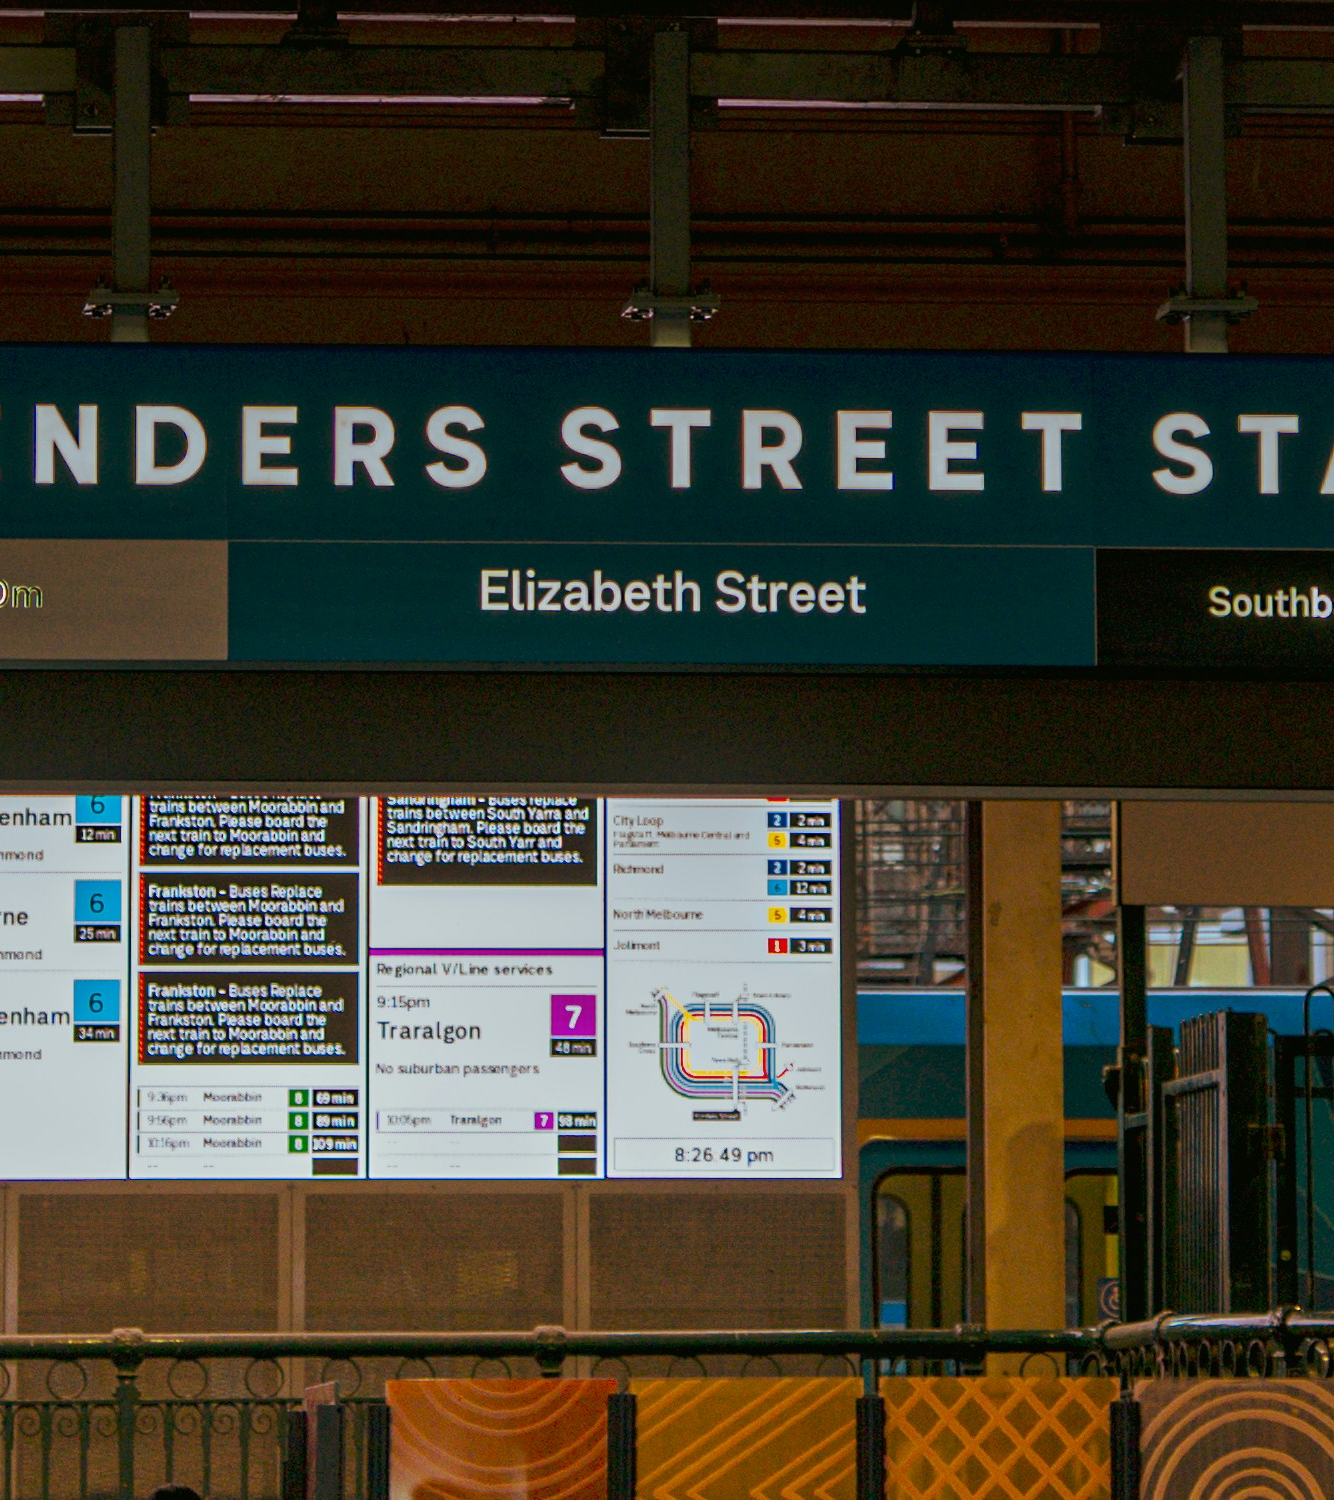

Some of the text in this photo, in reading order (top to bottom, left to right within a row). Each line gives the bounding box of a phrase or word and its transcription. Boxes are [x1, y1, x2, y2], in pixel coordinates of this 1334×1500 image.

[561, 407, 1083, 493] STREET
[477, 568, 867, 614] Elizabeth Street
[90, 795, 106, 814] 6
[613, 815, 664, 829] City Loop
[80, 828, 115, 840] 12 min
[89, 893, 105, 914] 6
[613, 909, 704, 920] North Melbourne
[78, 928, 116, 940] 25 min
[376, 963, 553, 978] Regional V/Line services
[88, 993, 104, 1013] 6
[377, 995, 430, 1011] 9:15pm
[565, 1005, 582, 1030] 7
[78, 1028, 115, 1040] 34 min
[377, 1021, 481, 1044] Traralgon
[555, 1041, 593, 1055] 48 min
[375, 1063, 540, 1078] No suburban passengers
[747, 1149, 774, 1167] pm
